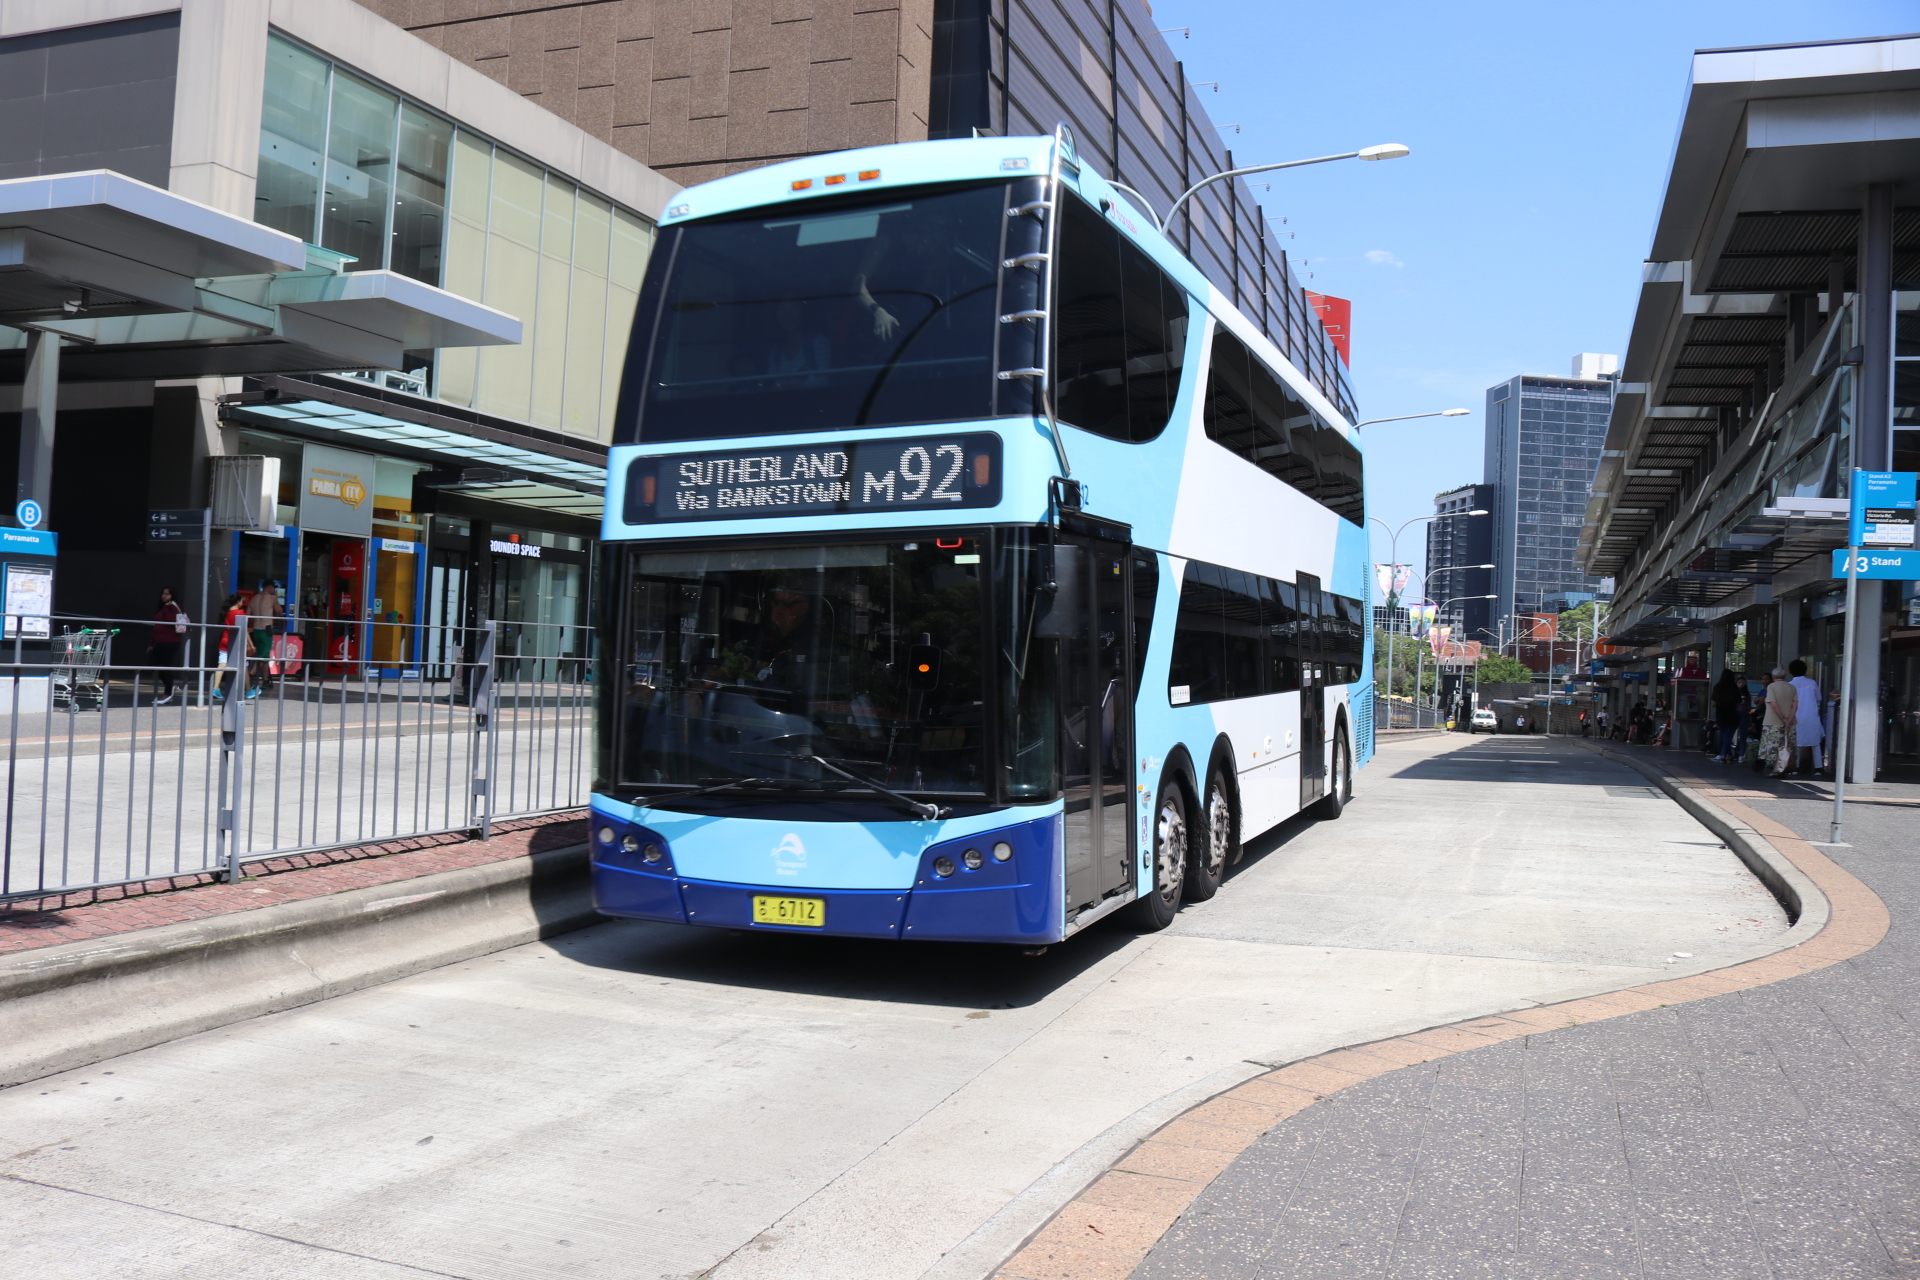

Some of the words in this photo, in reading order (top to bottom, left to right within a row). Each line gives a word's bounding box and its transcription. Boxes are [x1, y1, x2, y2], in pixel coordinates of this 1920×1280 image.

[679, 452, 848, 486] SUTHERLAND
[863, 445, 964, 502] M92
[675, 491, 709, 510] Via
[716, 481, 851, 507] BANKSTOWN
[25, 506, 35, 521] B
[4, 533, 40, 543] Parramatta
[520, 544, 541, 557] SPACE
[1871, 557, 1902, 566] Stand
